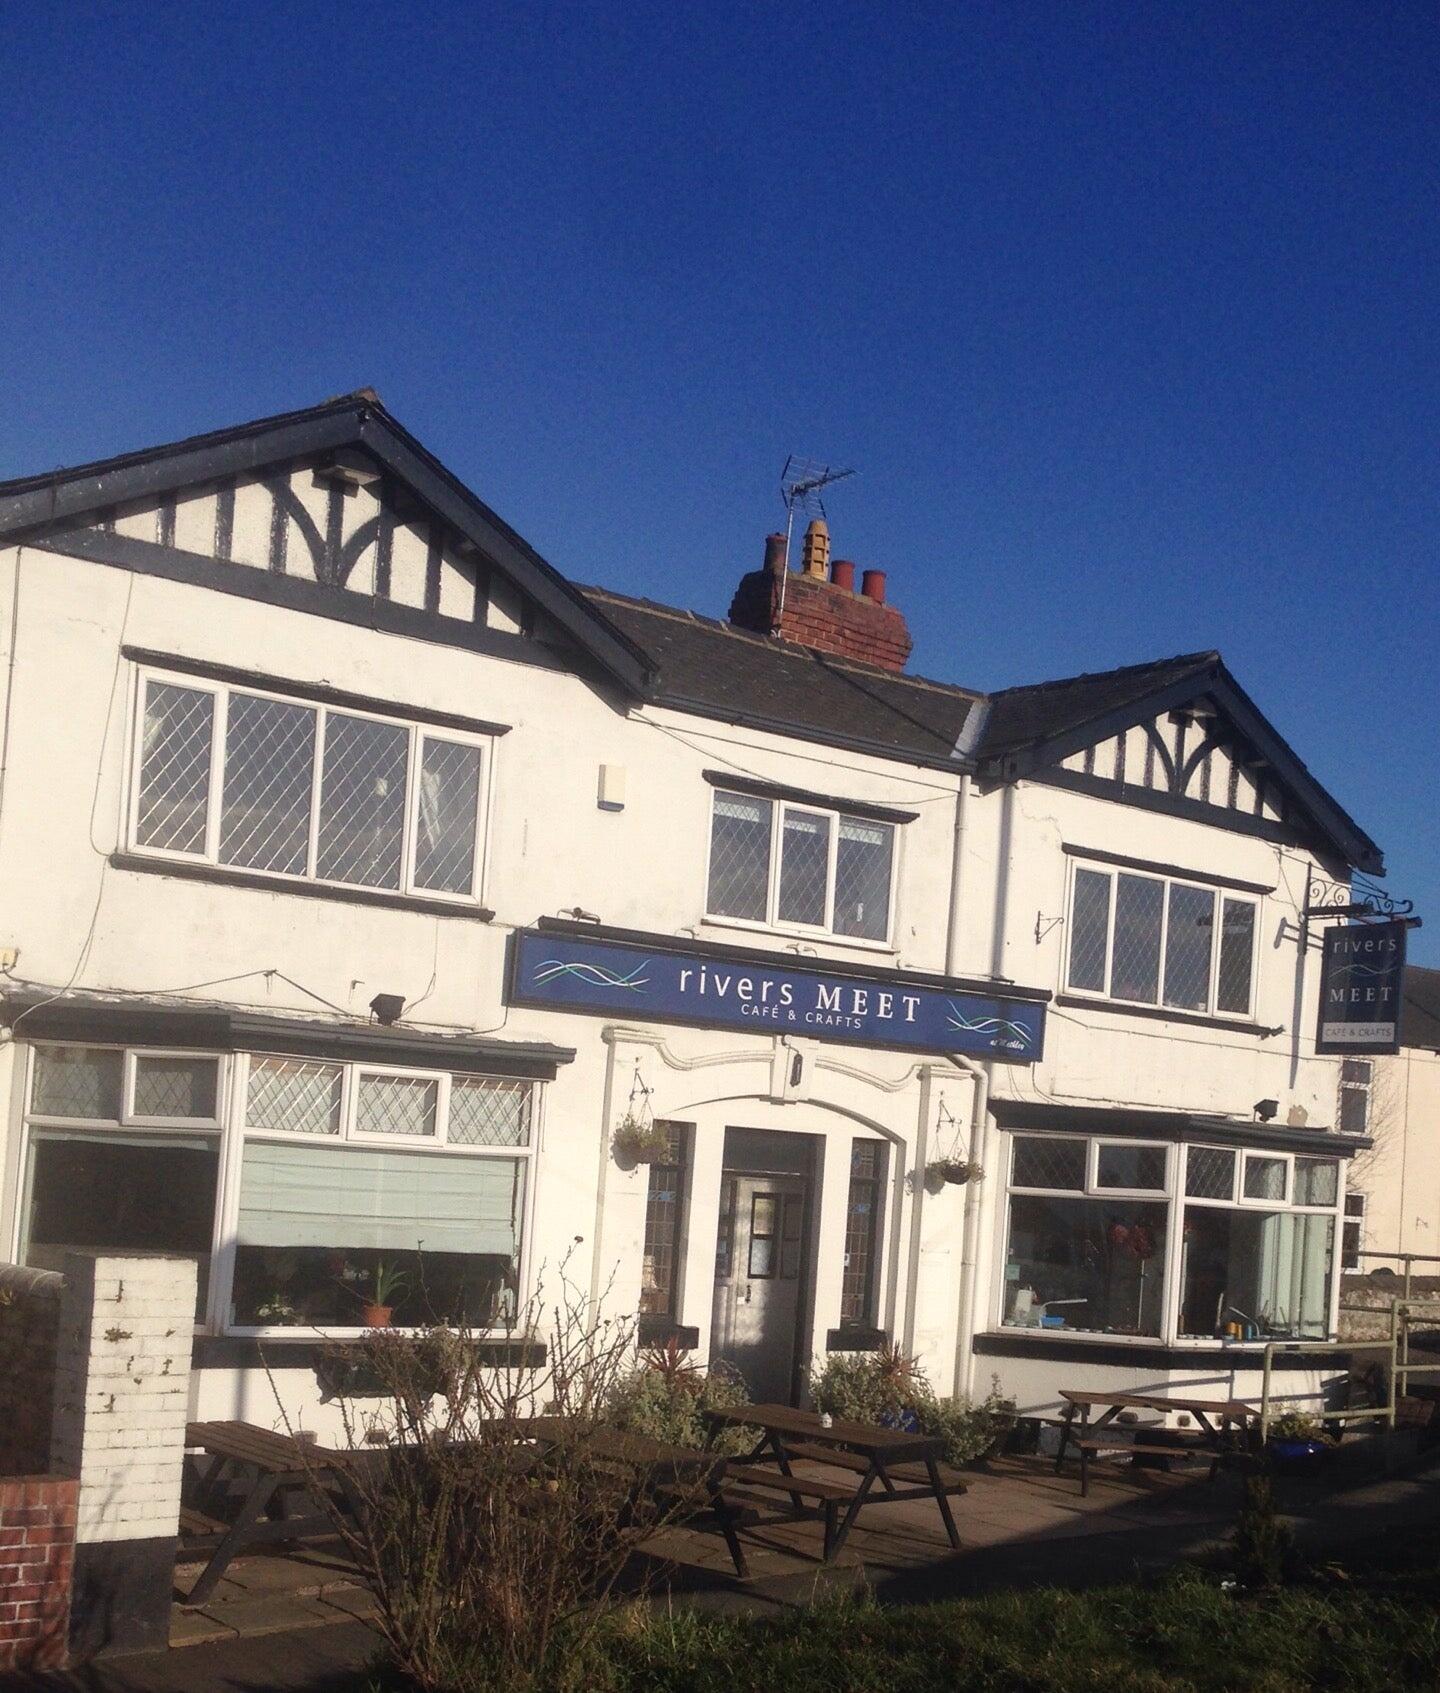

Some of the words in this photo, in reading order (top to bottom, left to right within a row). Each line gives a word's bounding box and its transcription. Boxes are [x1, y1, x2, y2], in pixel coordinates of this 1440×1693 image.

[1333, 938, 1396, 953] rivers
[679, 965, 793, 1006] rivers
[815, 984, 920, 1022] MEET
[1329, 987, 1392, 1002] MEET
[741, 1004, 779, 1018] CAFÉ
[788, 1009, 797, 1021] &
[805, 1012, 862, 1029] CRAFTS
[1358, 1027, 1393, 1037] CRAFTS
